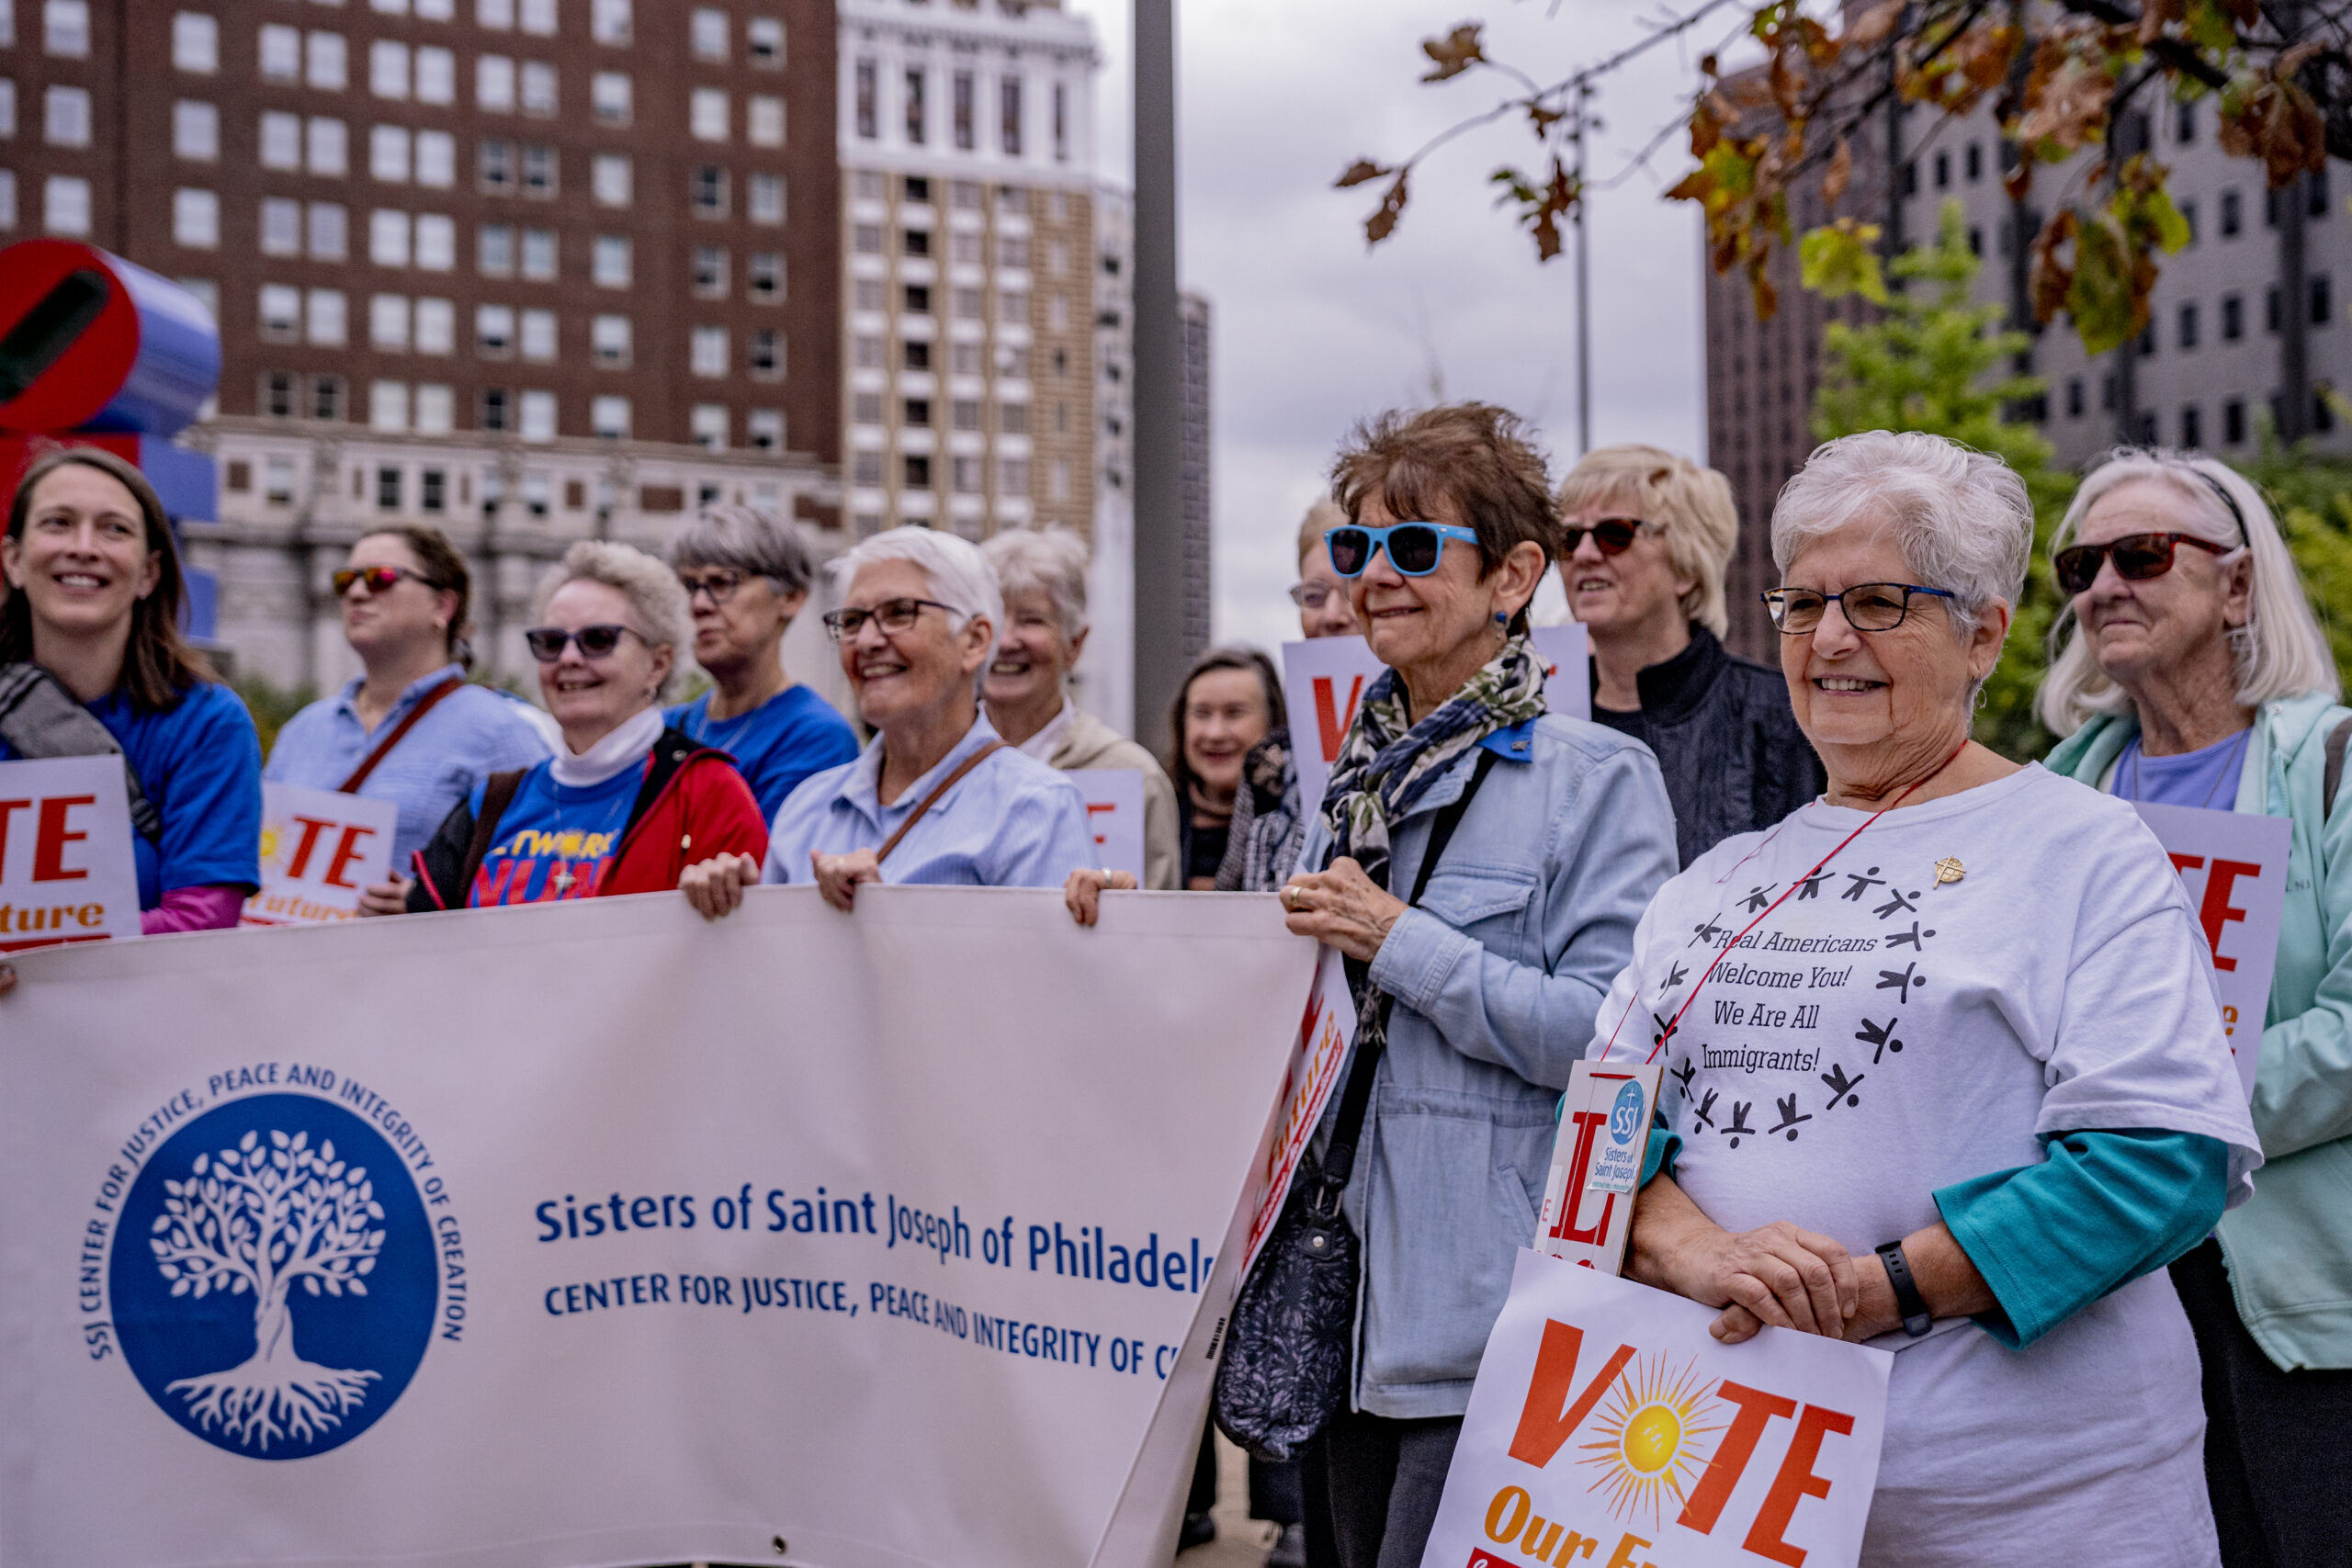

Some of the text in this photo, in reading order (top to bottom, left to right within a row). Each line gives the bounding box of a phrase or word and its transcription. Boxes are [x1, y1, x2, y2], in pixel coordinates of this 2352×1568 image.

[1713, 929, 1878, 953] Real Americans
[1708, 962, 1853, 988] Welcome You!
[1714, 1000, 1820, 1029] We Are All
[1702, 1043, 1821, 1074] Immigrants!
[1611, 1105, 1639, 1140] SSJ
[1594, 1161, 1612, 1177] Saint
[1604, 1146, 1627, 1163] Sisters
[78, 1063, 467, 1362] SSJ CENTER FOR JUSTICE, PEACE AND INTEGRITY OF CREATION
[535, 1191, 697, 1243] Sisters
[711, 1182, 753, 1231] of
[765, 1186, 878, 1235] Saint
[887, 1193, 971, 1265] Joseph
[982, 1215, 1014, 1269] of
[544, 1272, 672, 1316] CENTER
[678, 1274, 733, 1306] FOR
[741, 1277, 859, 1318] JUSTICE,
[869, 1282, 931, 1325] PEACE
[934, 1300, 968, 1340] AND
[973, 1313, 1102, 1368] INTEGRITY
[1110, 1337, 1145, 1375] OF
[1485, 1484, 1599, 1568] Our
